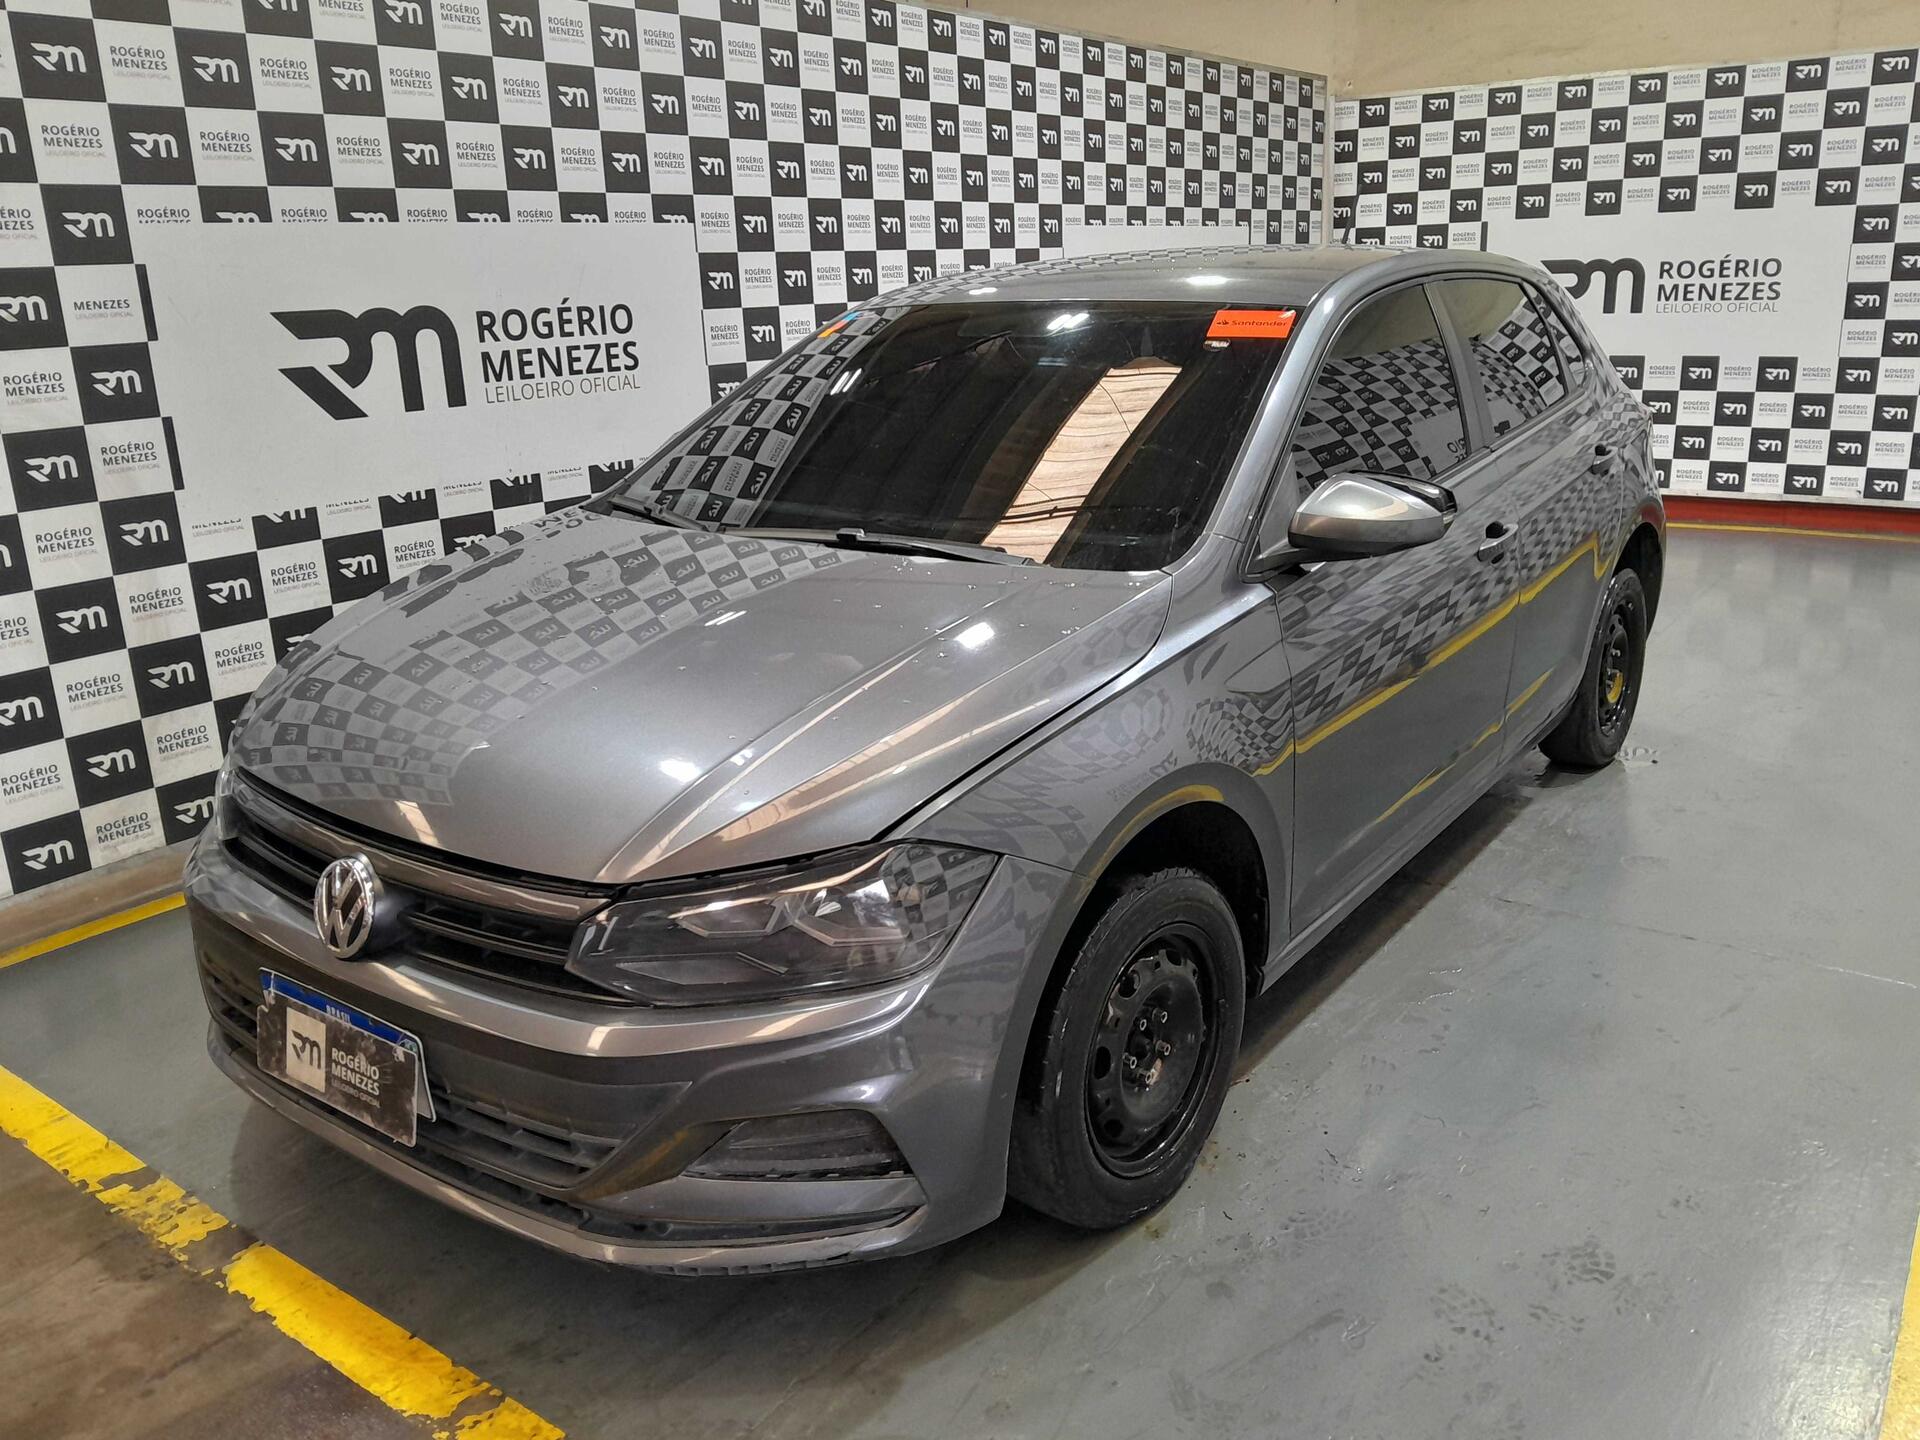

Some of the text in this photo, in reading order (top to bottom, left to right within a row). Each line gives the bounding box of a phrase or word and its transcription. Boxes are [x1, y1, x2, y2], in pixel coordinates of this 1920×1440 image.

[439, 2, 480, 16] ROGÉRIO
[441, 12, 481, 25] MENEZES
[547, 16, 583, 28] ROGÉRIO
[548, 25, 584, 37] MENEZES
[643, 28, 674, 40] ROGÉRIO
[644, 37, 675, 48] MENEZES
[727, 39, 755, 50] ROGÉRIO
[108, 45, 165, 59] ROGÉRIO
[728, 47, 756, 58] MENEZES
[111, 57, 167, 70] MENEZES
[259, 57, 307, 70] ROGÉRIO
[260, 68, 309, 80] MENEZES
[389, 67, 431, 80] ROGÉRIO
[390, 78, 433, 89] MENEZES
[502, 77, 539, 89] ROGÉRIO
[503, 87, 541, 98] MENEZES
[602, 86, 635, 97] ROGÉRIO
[603, 95, 636, 105] MENEZES
[691, 94, 720, 104] ROGÉRIO
[692, 103, 721, 112] MENEZES
[770, 101, 796, 111] ROGÉRIO
[770, 109, 797, 118] MENEZES
[40, 123, 100, 137] ROGÉRIO
[199, 129, 250, 142] ROGÉRIO
[42, 136, 102, 148] MENEZES
[201, 142, 252, 152] MENEZES
[336, 135, 380, 147] ROGÉRIO
[455, 141, 494, 152] ROGÉRIO
[337, 147, 382, 157] MENEZES
[457, 151, 496, 161] MENEZES
[560, 146, 595, 156] ROGÉRIO
[653, 151, 683, 160] ROGÉRIO
[561, 156, 596, 165] MENEZES
[654, 160, 685, 168] MENEZES
[736, 155, 763, 164] ROGÉRIO
[736, 164, 764, 172] MENEZES
[136, 206, 190, 218] ROGÉRIO
[281, 206, 328, 217] ROGÉRIO
[406, 207, 447, 218] ROGÉRIO
[517, 208, 553, 218] ROGÉRIO
[614, 209, 646, 219] ROGÉRIO
[700, 211, 728, 219] ROGÉRIO
[777, 212, 803, 220] ROGÉRIO
[744, 266, 770, 275] ROGÉRIO
[1658, 254, 1783, 279] ROGÉRIO
[745, 275, 771, 283] MENEZES
[1656, 281, 1782, 303] MENEZES
[72, 298, 130, 311] MENEZES
[1655, 301, 1779, 314] LEILOEIRO OFICIAL
[476, 298, 633, 343] ROGÉRIO
[1231, 319, 1288, 327] Santander
[709, 323, 737, 332] ROGÉRIO
[710, 332, 738, 340] MENEZES
[480, 341, 640, 384] MENEZES
[2, 371, 62, 386] ROGÉRIO
[4, 382, 65, 397] MENEZES
[485, 373, 641, 404] LEILOEIRO OFICIAL
[100, 441, 155, 456] ROGÉRIO
[102, 451, 158, 466] MENEZES
[34, 526, 92, 544] ROGÉRIO
[36, 536, 95, 554] MENEZES
[393, 540, 434, 554] ROGÉRIO
[395, 548, 436, 563] MENEZES
[270, 561, 316, 577] ROGÉRIO
[272, 570, 318, 586] MENEZES
[128, 586, 181, 604] ROGÉRIO
[130, 595, 184, 614] MENEZES
[214, 640, 263, 659] ROGÉRIO
[216, 649, 265, 668] MENEZES
[65, 672, 121, 693] ROGÉRIO
[68, 682, 124, 703] MENEZES
[156, 724, 207, 745] ROGÉRIO
[158, 733, 209, 754] MENEZES
[0, 763, 58, 788] ROGÉRIO
[2, 773, 61, 798] MENEZES
[95, 811, 148, 835] ROGÉRIO
[97, 820, 151, 844] MENEZES
[332, 1047, 380, 1080] ROGÉRIO
[331, 1062, 380, 1095] MENEZES
